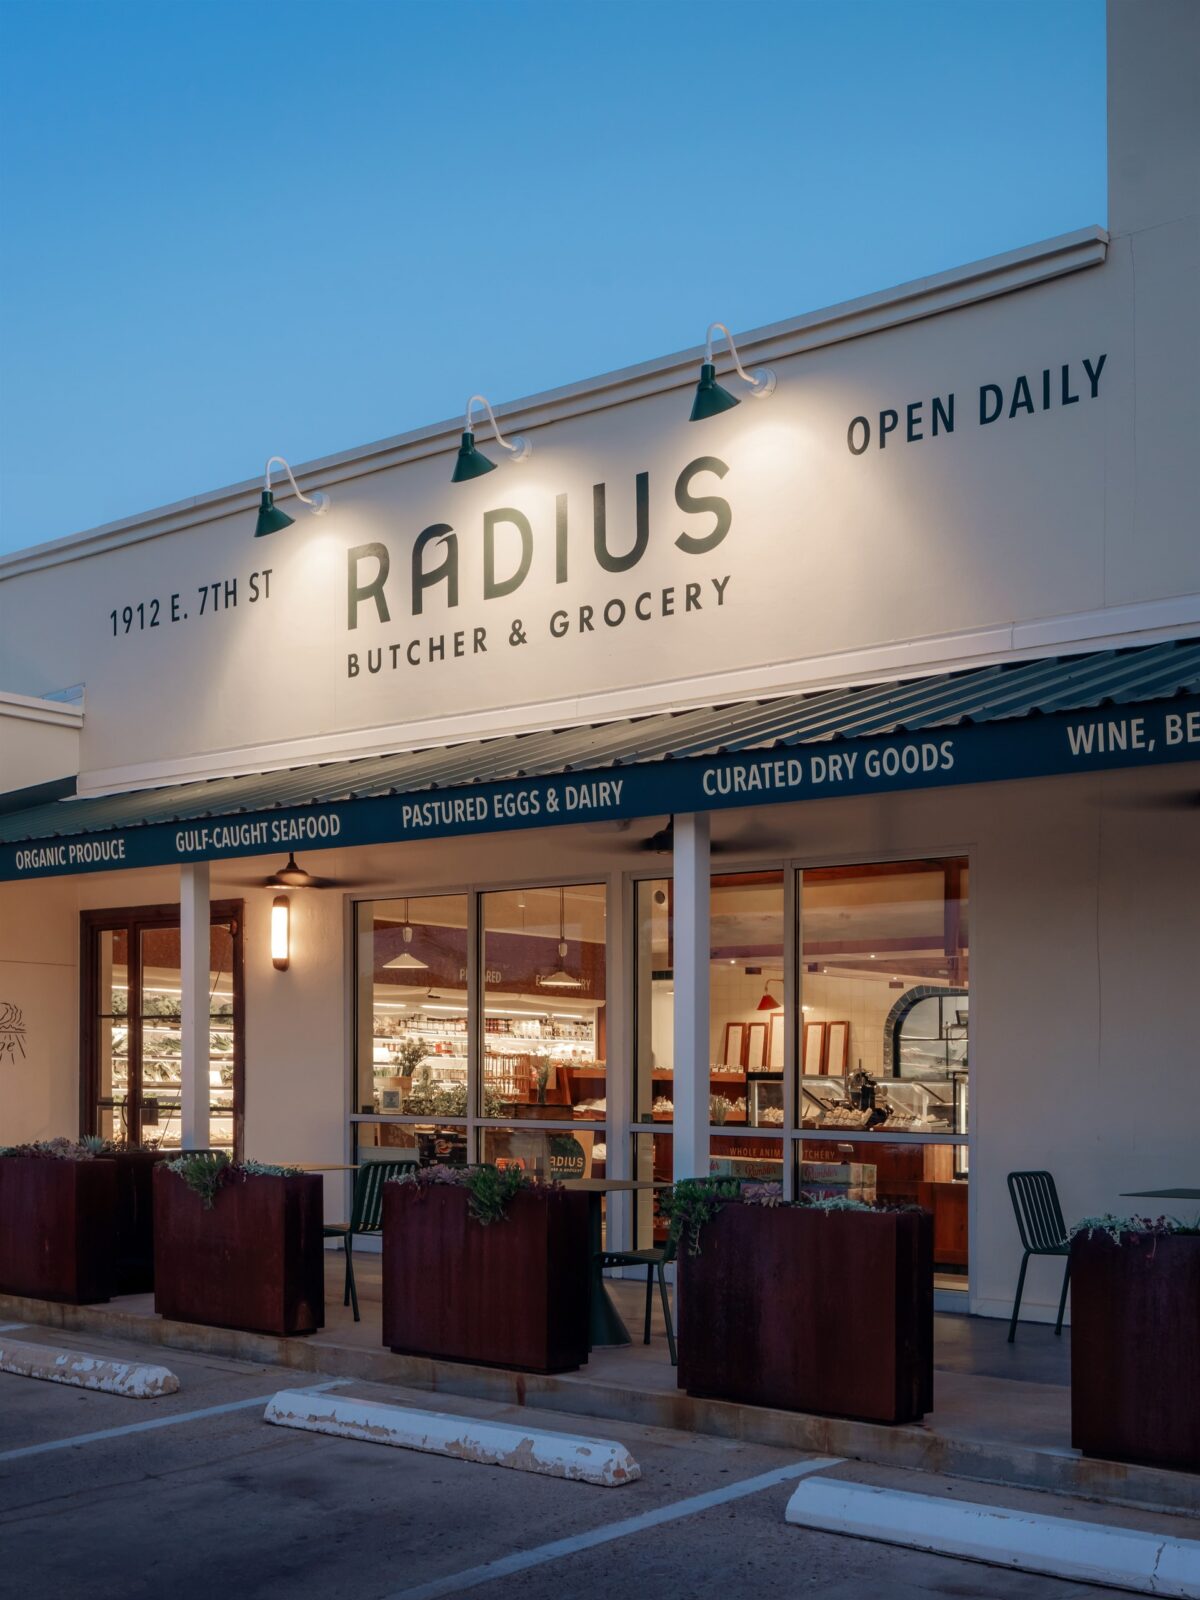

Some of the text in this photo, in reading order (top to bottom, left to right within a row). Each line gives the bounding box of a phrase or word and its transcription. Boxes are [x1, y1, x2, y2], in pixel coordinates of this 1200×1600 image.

[847, 354, 1107, 456] OPEN DAILY
[347, 455, 732, 631] RADIUS
[110, 569, 273, 637] 1912 E. 7TH ST
[347, 575, 731, 678] BUTCHER & GROCERY
[1066, 718, 1155, 756] WINE,
[702, 741, 954, 796] CURATED DRY GOODS
[402, 779, 624, 829] PASTURED EGGS & DAIRY
[15, 838, 126, 871] ORGANIC PRODUCE
[175, 814, 341, 852] GULF-CAUGHT SEAFOOD
[549, 1155, 584, 1168] ADIUS
[729, 1147, 757, 1157] WHOLE
